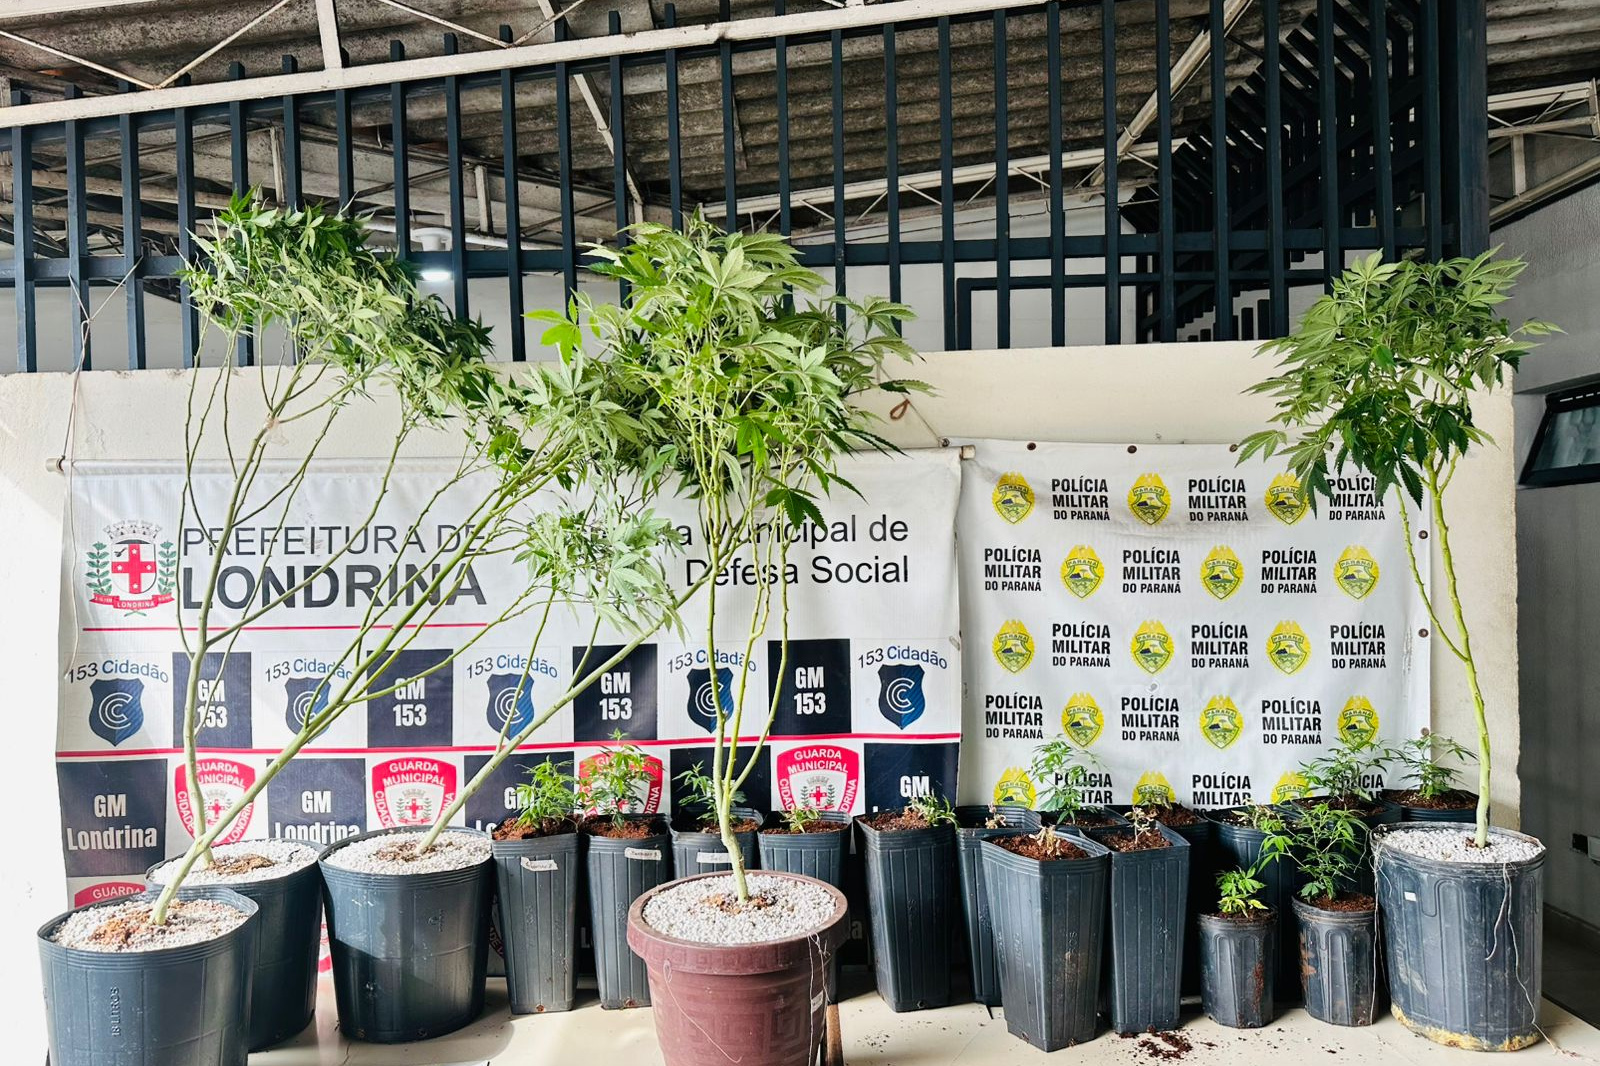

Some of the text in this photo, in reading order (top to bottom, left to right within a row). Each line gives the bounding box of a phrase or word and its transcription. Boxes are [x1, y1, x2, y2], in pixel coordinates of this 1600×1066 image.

[1052, 476, 1108, 493] POLÍCIA
[1188, 476, 1246, 493] POLÍCIA
[1327, 474, 1375, 491] POLÍCI
[1053, 494, 1109, 509] MILITAR
[1189, 494, 1246, 509] MILITAR
[1054, 508, 1110, 521] DO PARANÁ
[1189, 509, 1248, 521] DO PARANÁ
[1329, 508, 1385, 521] DO PARANÁ
[868, 514, 909, 542] de
[183, 524, 487, 556] PREFEITURA DE
[984, 544, 1041, 563] POLÍCIA
[1123, 546, 1180, 564] POLÍCIA
[1262, 546, 1316, 564] POLÍCIA
[686, 555, 908, 587] Defesa Social
[984, 564, 1041, 580] MILITAR
[1123, 565, 1180, 580] MILITAR
[1261, 566, 1316, 581] MILITAR
[183, 563, 487, 610] LONDRINA
[985, 579, 1041, 591] DO PARANÁ
[1123, 581, 1181, 593] DO PARANÁ
[1261, 581, 1317, 593] DO PARANÁ
[1052, 620, 1110, 638] POLÍCIA
[1191, 621, 1248, 639] POLÍCIA
[1330, 622, 1385, 639] POLÍCIA
[1052, 639, 1110, 654] MILITAR
[1191, 640, 1248, 655] MILITAR
[1331, 641, 1385, 657] MILITAR
[667, 652, 693, 673] 153
[858, 645, 948, 669] 153 Cidadão
[1053, 655, 1111, 667] DO PARANÁ
[1192, 655, 1249, 668] DO PARANÁ
[1332, 656, 1386, 669] DO PARANÁ
[68, 659, 169, 683] 153 Cidadão
[265, 661, 291, 682] 153
[466, 654, 558, 678] 153 Cidadão
[600, 672, 631, 695] GM
[795, 666, 824, 689] GM
[197, 679, 226, 702] GM
[394, 677, 425, 700] GM
[599, 697, 633, 721] 153
[793, 692, 827, 715] 153
[986, 692, 1043, 710] POLÍCIA
[1121, 694, 1179, 711] POLÍCIA
[1261, 697, 1321, 715] POLÍCIA
[393, 704, 427, 726] 153
[986, 711, 1043, 725] MILITAR
[1122, 712, 1179, 728] MILITAR
[1262, 716, 1321, 731] MILITAR
[986, 726, 1043, 739] DO PARANÁ
[1122, 729, 1180, 741] DO PARANÁ
[1263, 732, 1321, 744] DO PARANÁ
[794, 749, 842, 761] GUARDA
[389, 761, 439, 773] GUARDA
[787, 760, 848, 775] MUNICIPAL
[198, 773, 246, 788] UNICIPAL
[383, 773, 446, 787] MUNICIPAL
[900, 775, 930, 797] GM
[1192, 771, 1251, 789] POLÍCIA
[301, 790, 332, 813] GM
[779, 778, 795, 811] CIDAD
[94, 793, 127, 817] GM
[66, 826, 158, 851] Londrina
